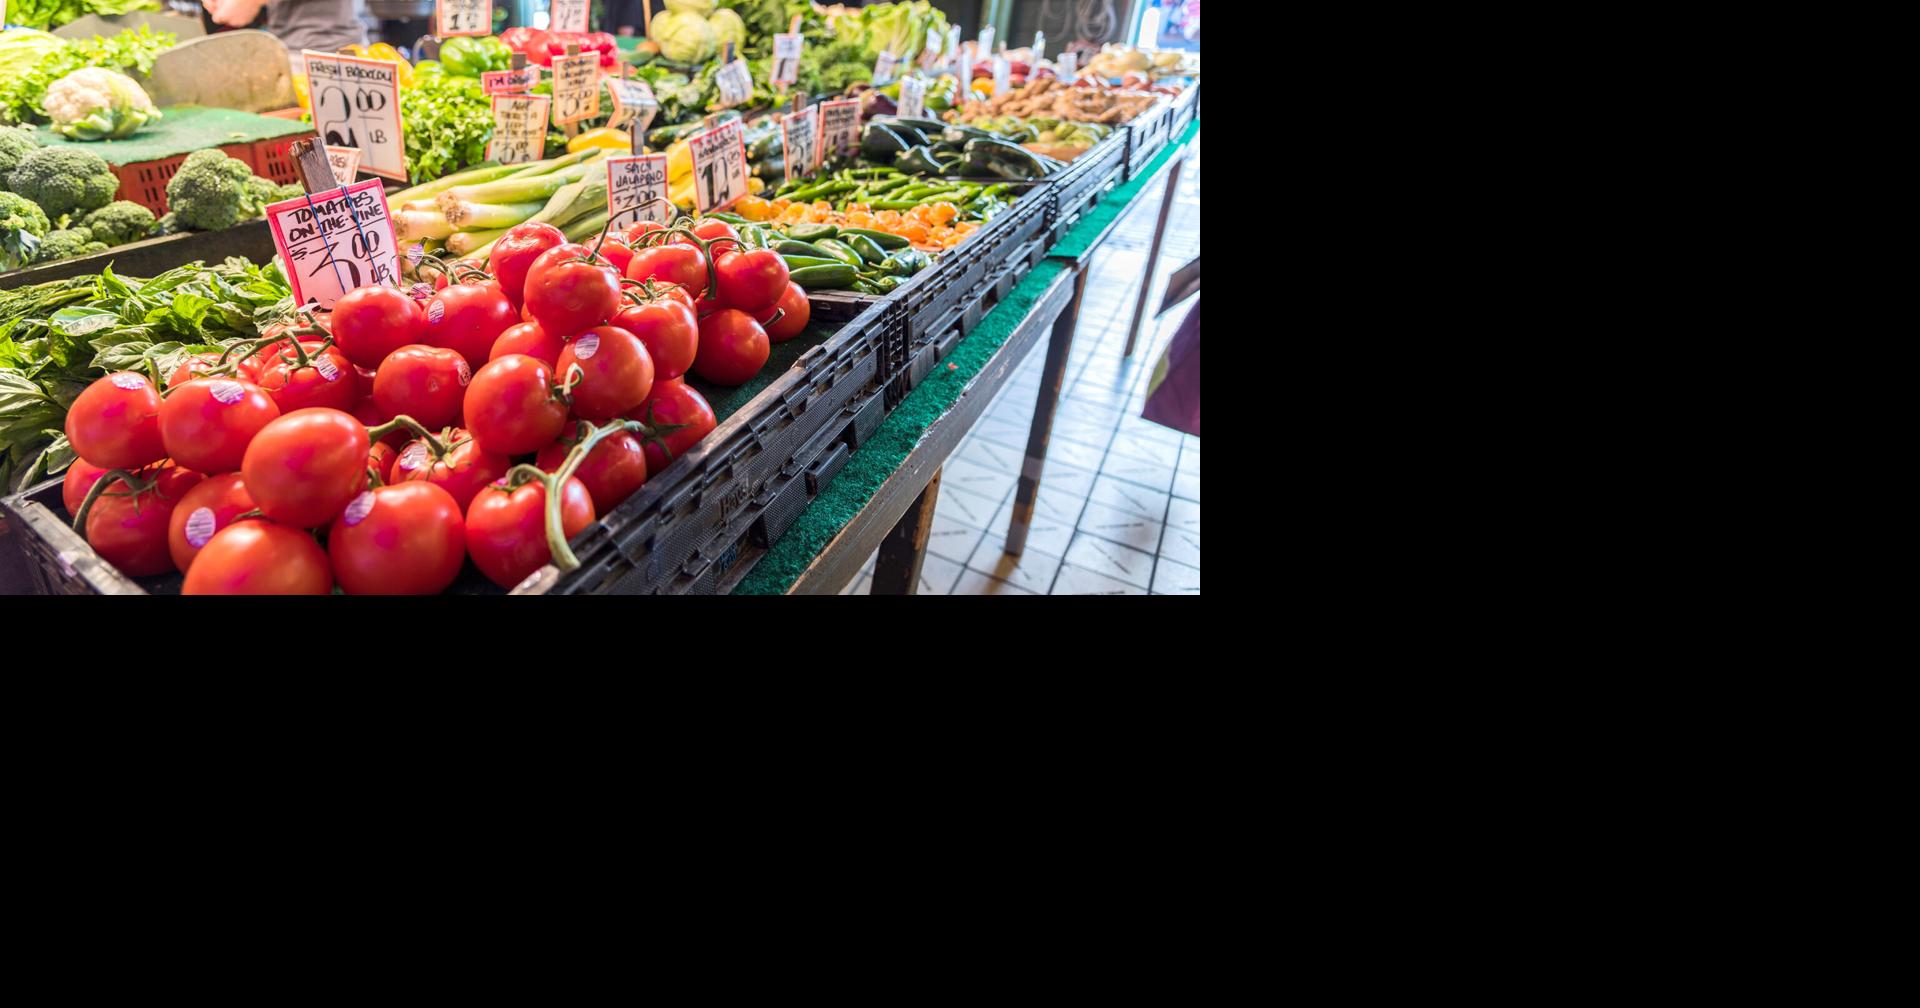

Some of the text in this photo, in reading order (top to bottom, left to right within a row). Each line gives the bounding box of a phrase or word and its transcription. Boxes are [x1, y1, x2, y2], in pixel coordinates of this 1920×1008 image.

[310, 62, 342, 79] FRESH
[369, 129, 388, 144] LB
[287, 191, 374, 224] TOMATOES
[370, 264, 390, 284] LB
